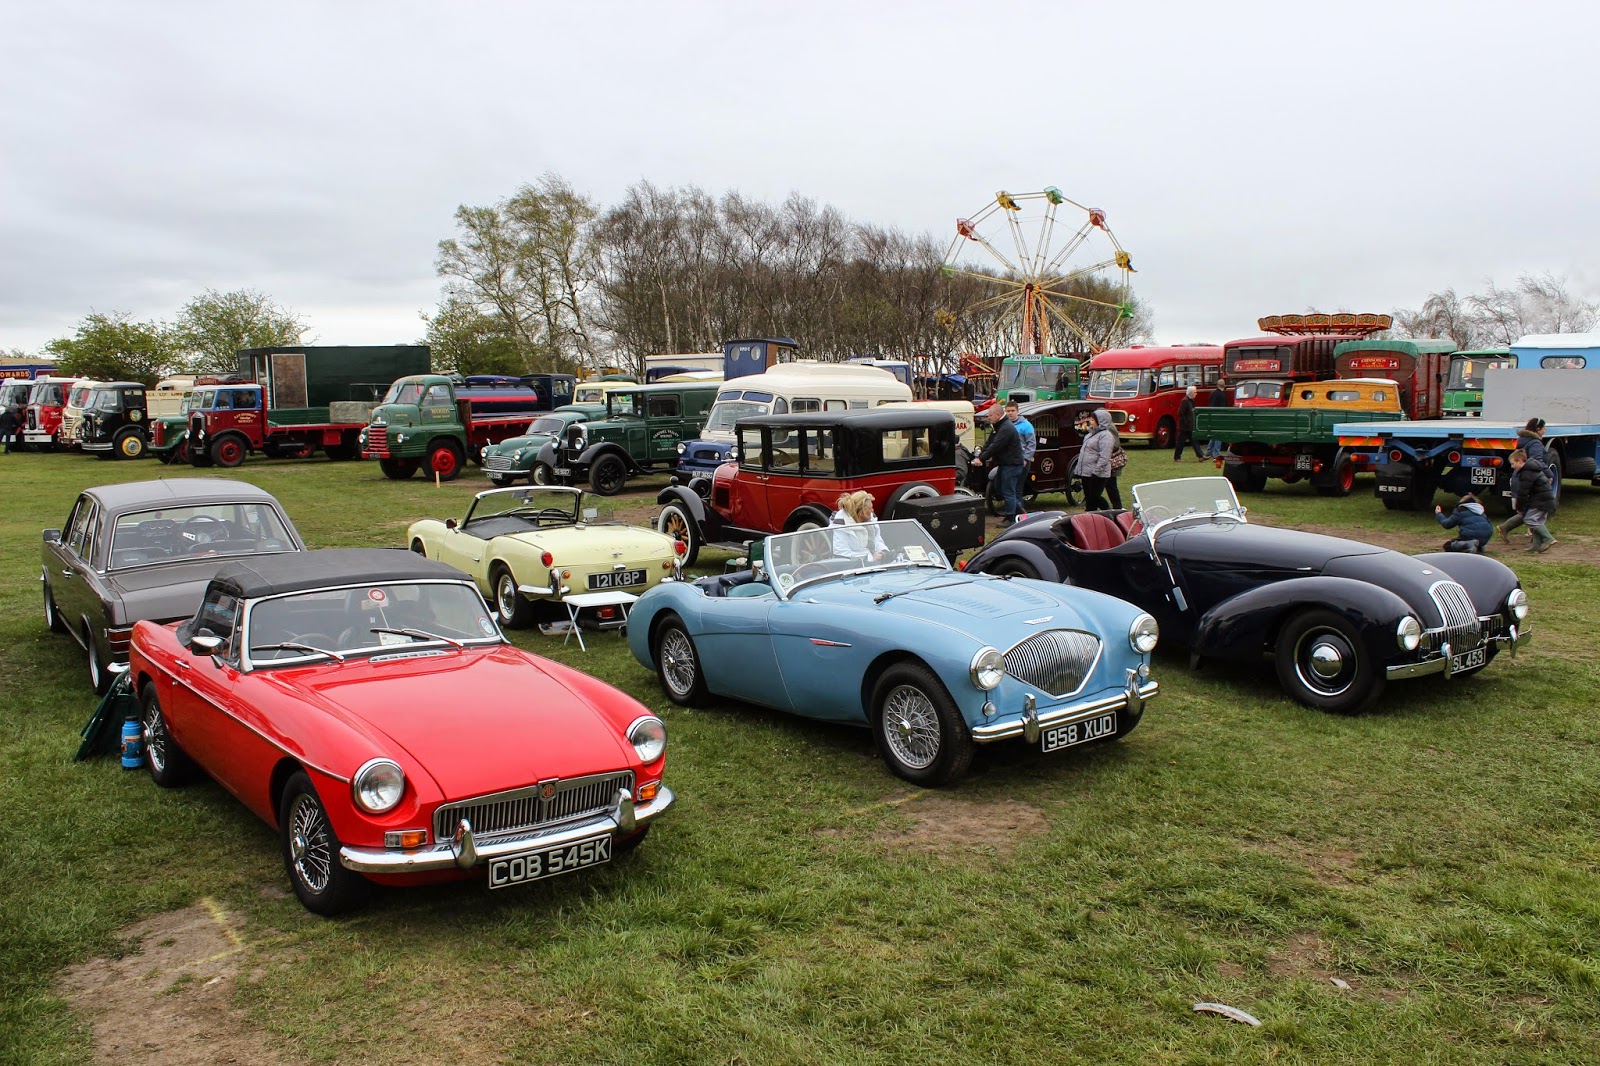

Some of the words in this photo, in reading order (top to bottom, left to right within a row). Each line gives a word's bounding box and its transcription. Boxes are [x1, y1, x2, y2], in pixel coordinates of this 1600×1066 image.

[1472, 476, 1494, 484] 537G
[1475, 468, 1492, 476] GMB
[596, 574, 612, 588] 121
[614, 571, 640, 586] KBP
[1452, 656, 1465, 671] SL
[1466, 650, 1483, 667] 453
[1047, 725, 1078, 748] 958
[1084, 715, 1112, 739] XUD
[543, 784, 555, 798] MG
[492, 855, 542, 885] COB
[548, 838, 609, 873] 545K
